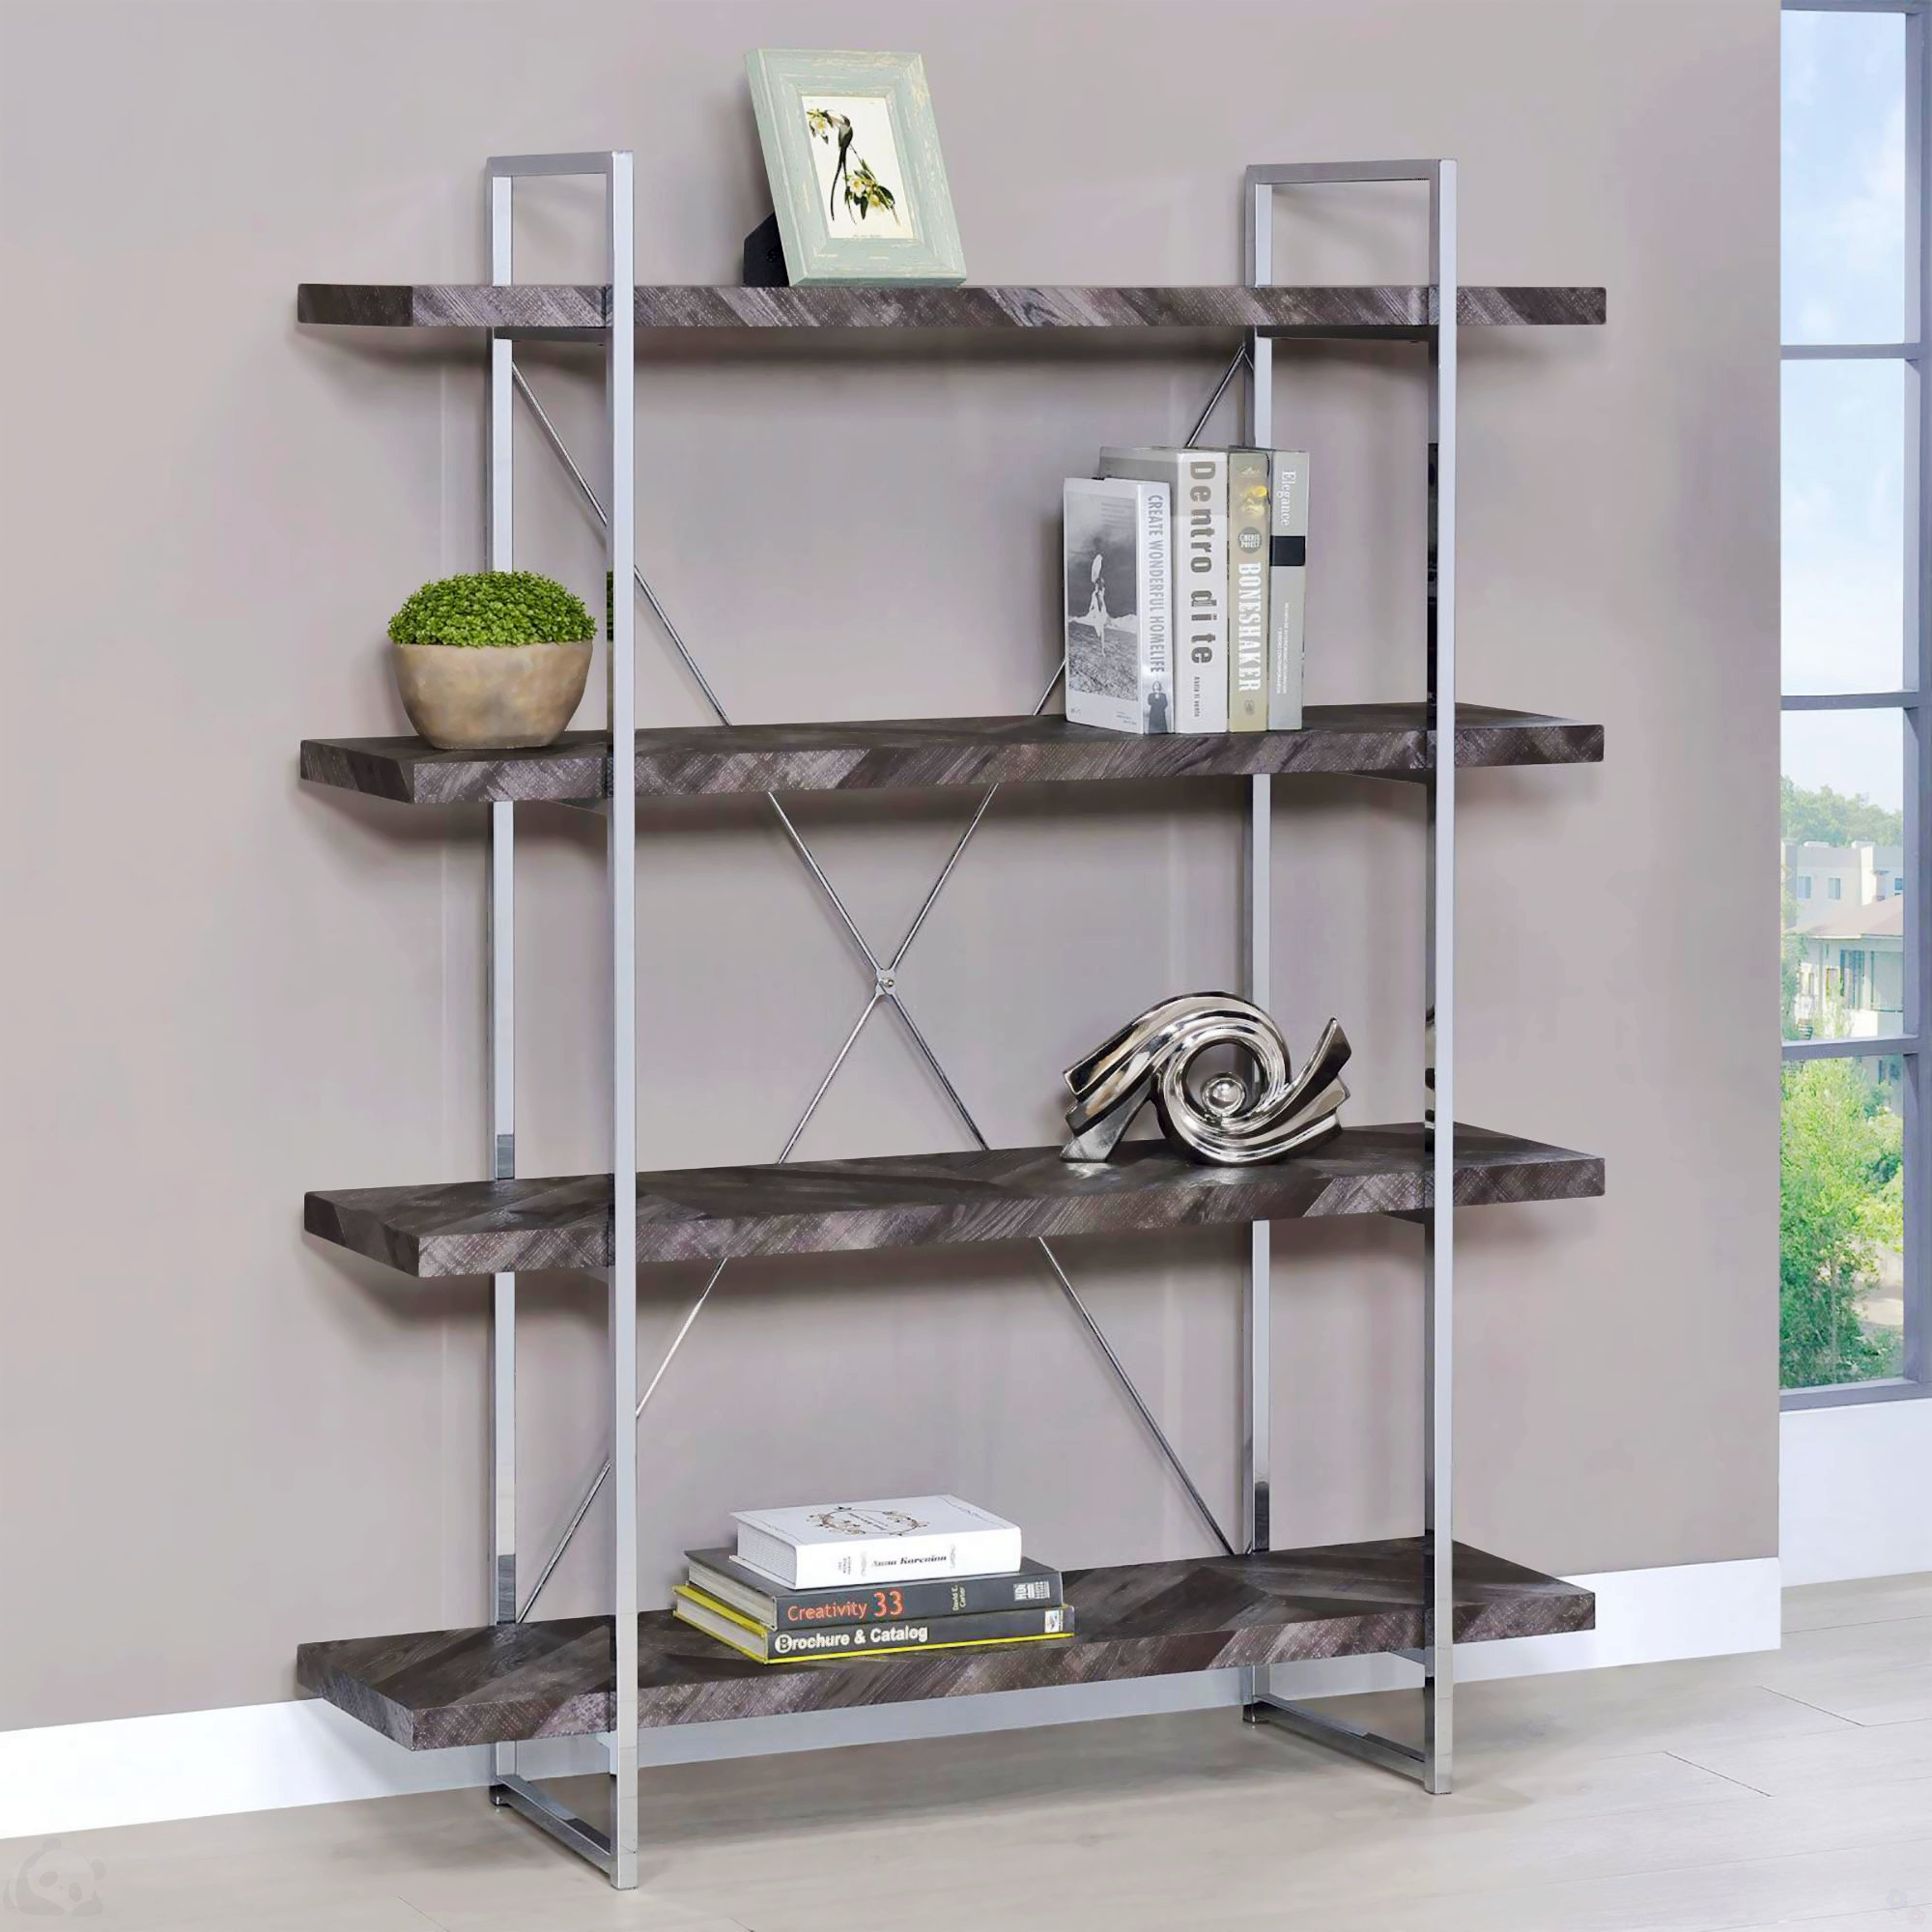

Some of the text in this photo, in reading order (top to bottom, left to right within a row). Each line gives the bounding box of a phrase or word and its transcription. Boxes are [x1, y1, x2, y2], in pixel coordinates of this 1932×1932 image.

[1275, 470, 1296, 526] Elegance
[1148, 495, 1165, 673] CREATE WONDERFUL HOMELIFE
[1189, 461, 1217, 665] Dentro di te
[1237, 561, 1262, 693] BONESHAKER
[775, 1623, 928, 1654] Brochure & Catalog
[787, 1590, 903, 1623] Creativity 33
